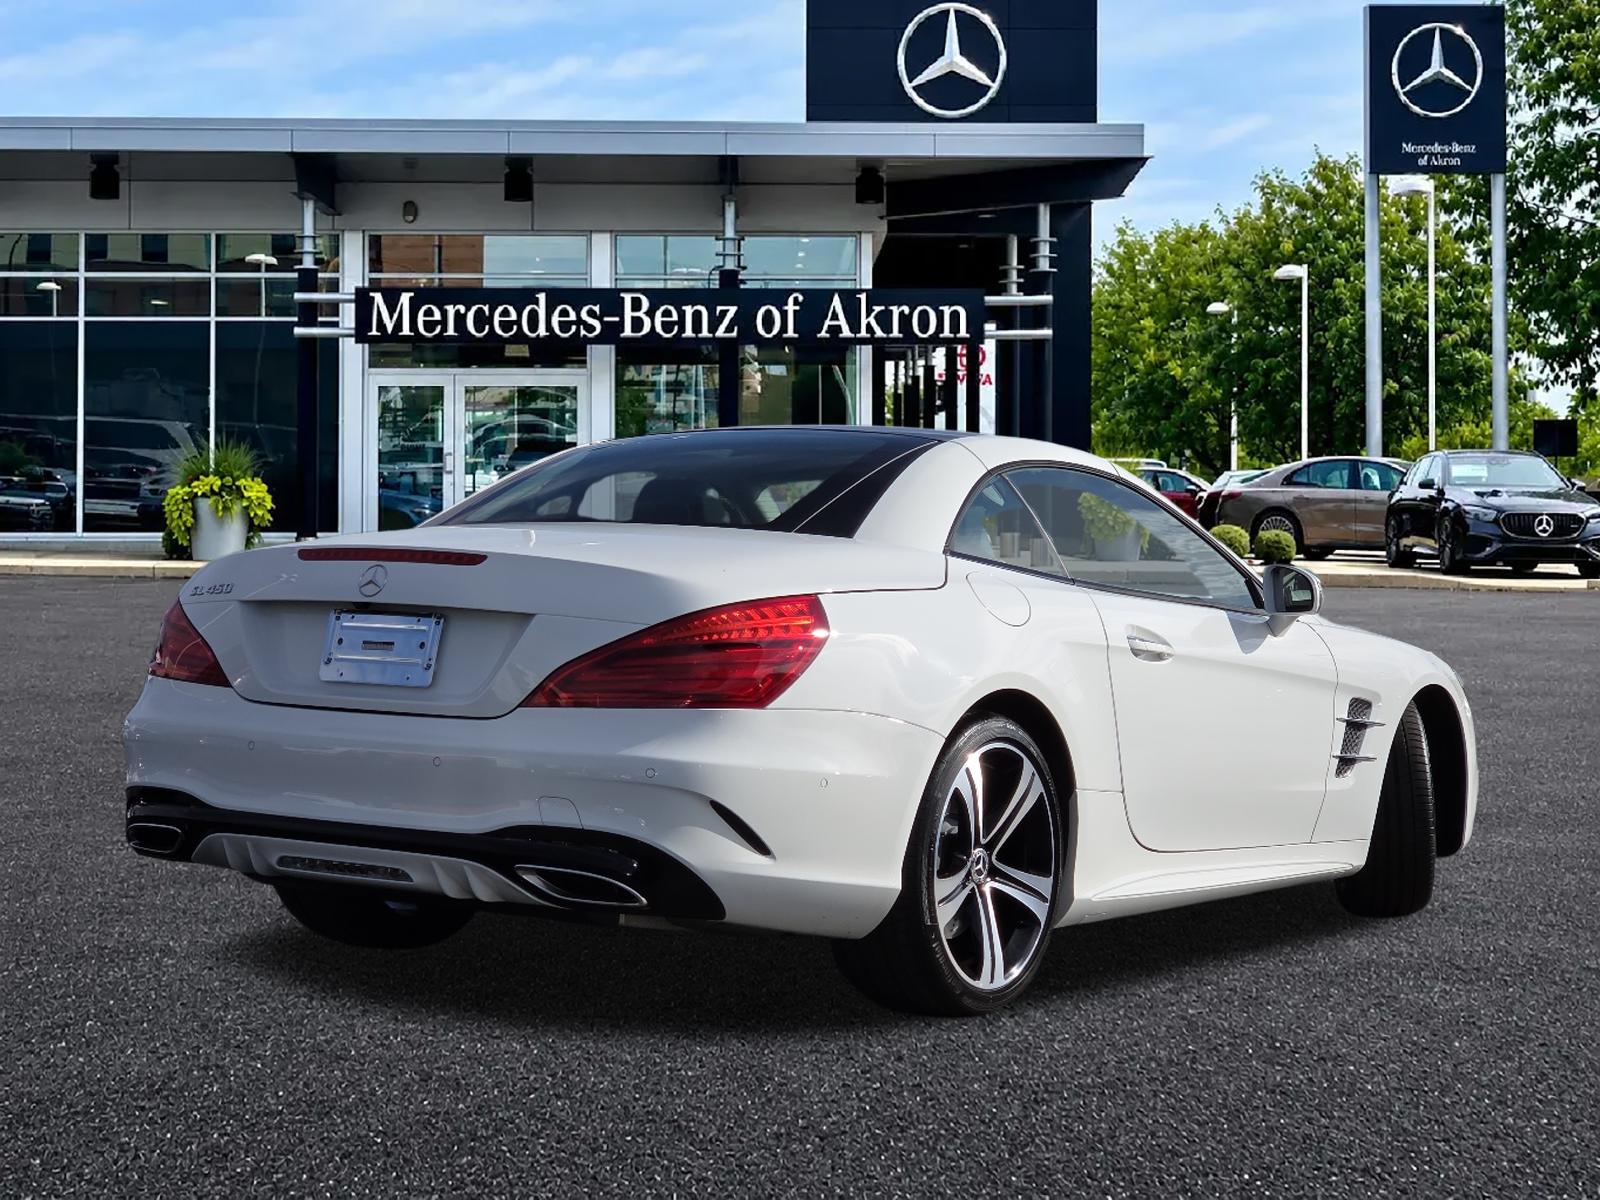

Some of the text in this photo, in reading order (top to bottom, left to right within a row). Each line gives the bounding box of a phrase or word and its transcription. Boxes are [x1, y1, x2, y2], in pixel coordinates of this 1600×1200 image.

[1401, 142, 1476, 154] Mercedes-Benz
[1418, 154, 1461, 166] of Akron
[367, 292, 970, 339] Mercedes-Benz of Akron
